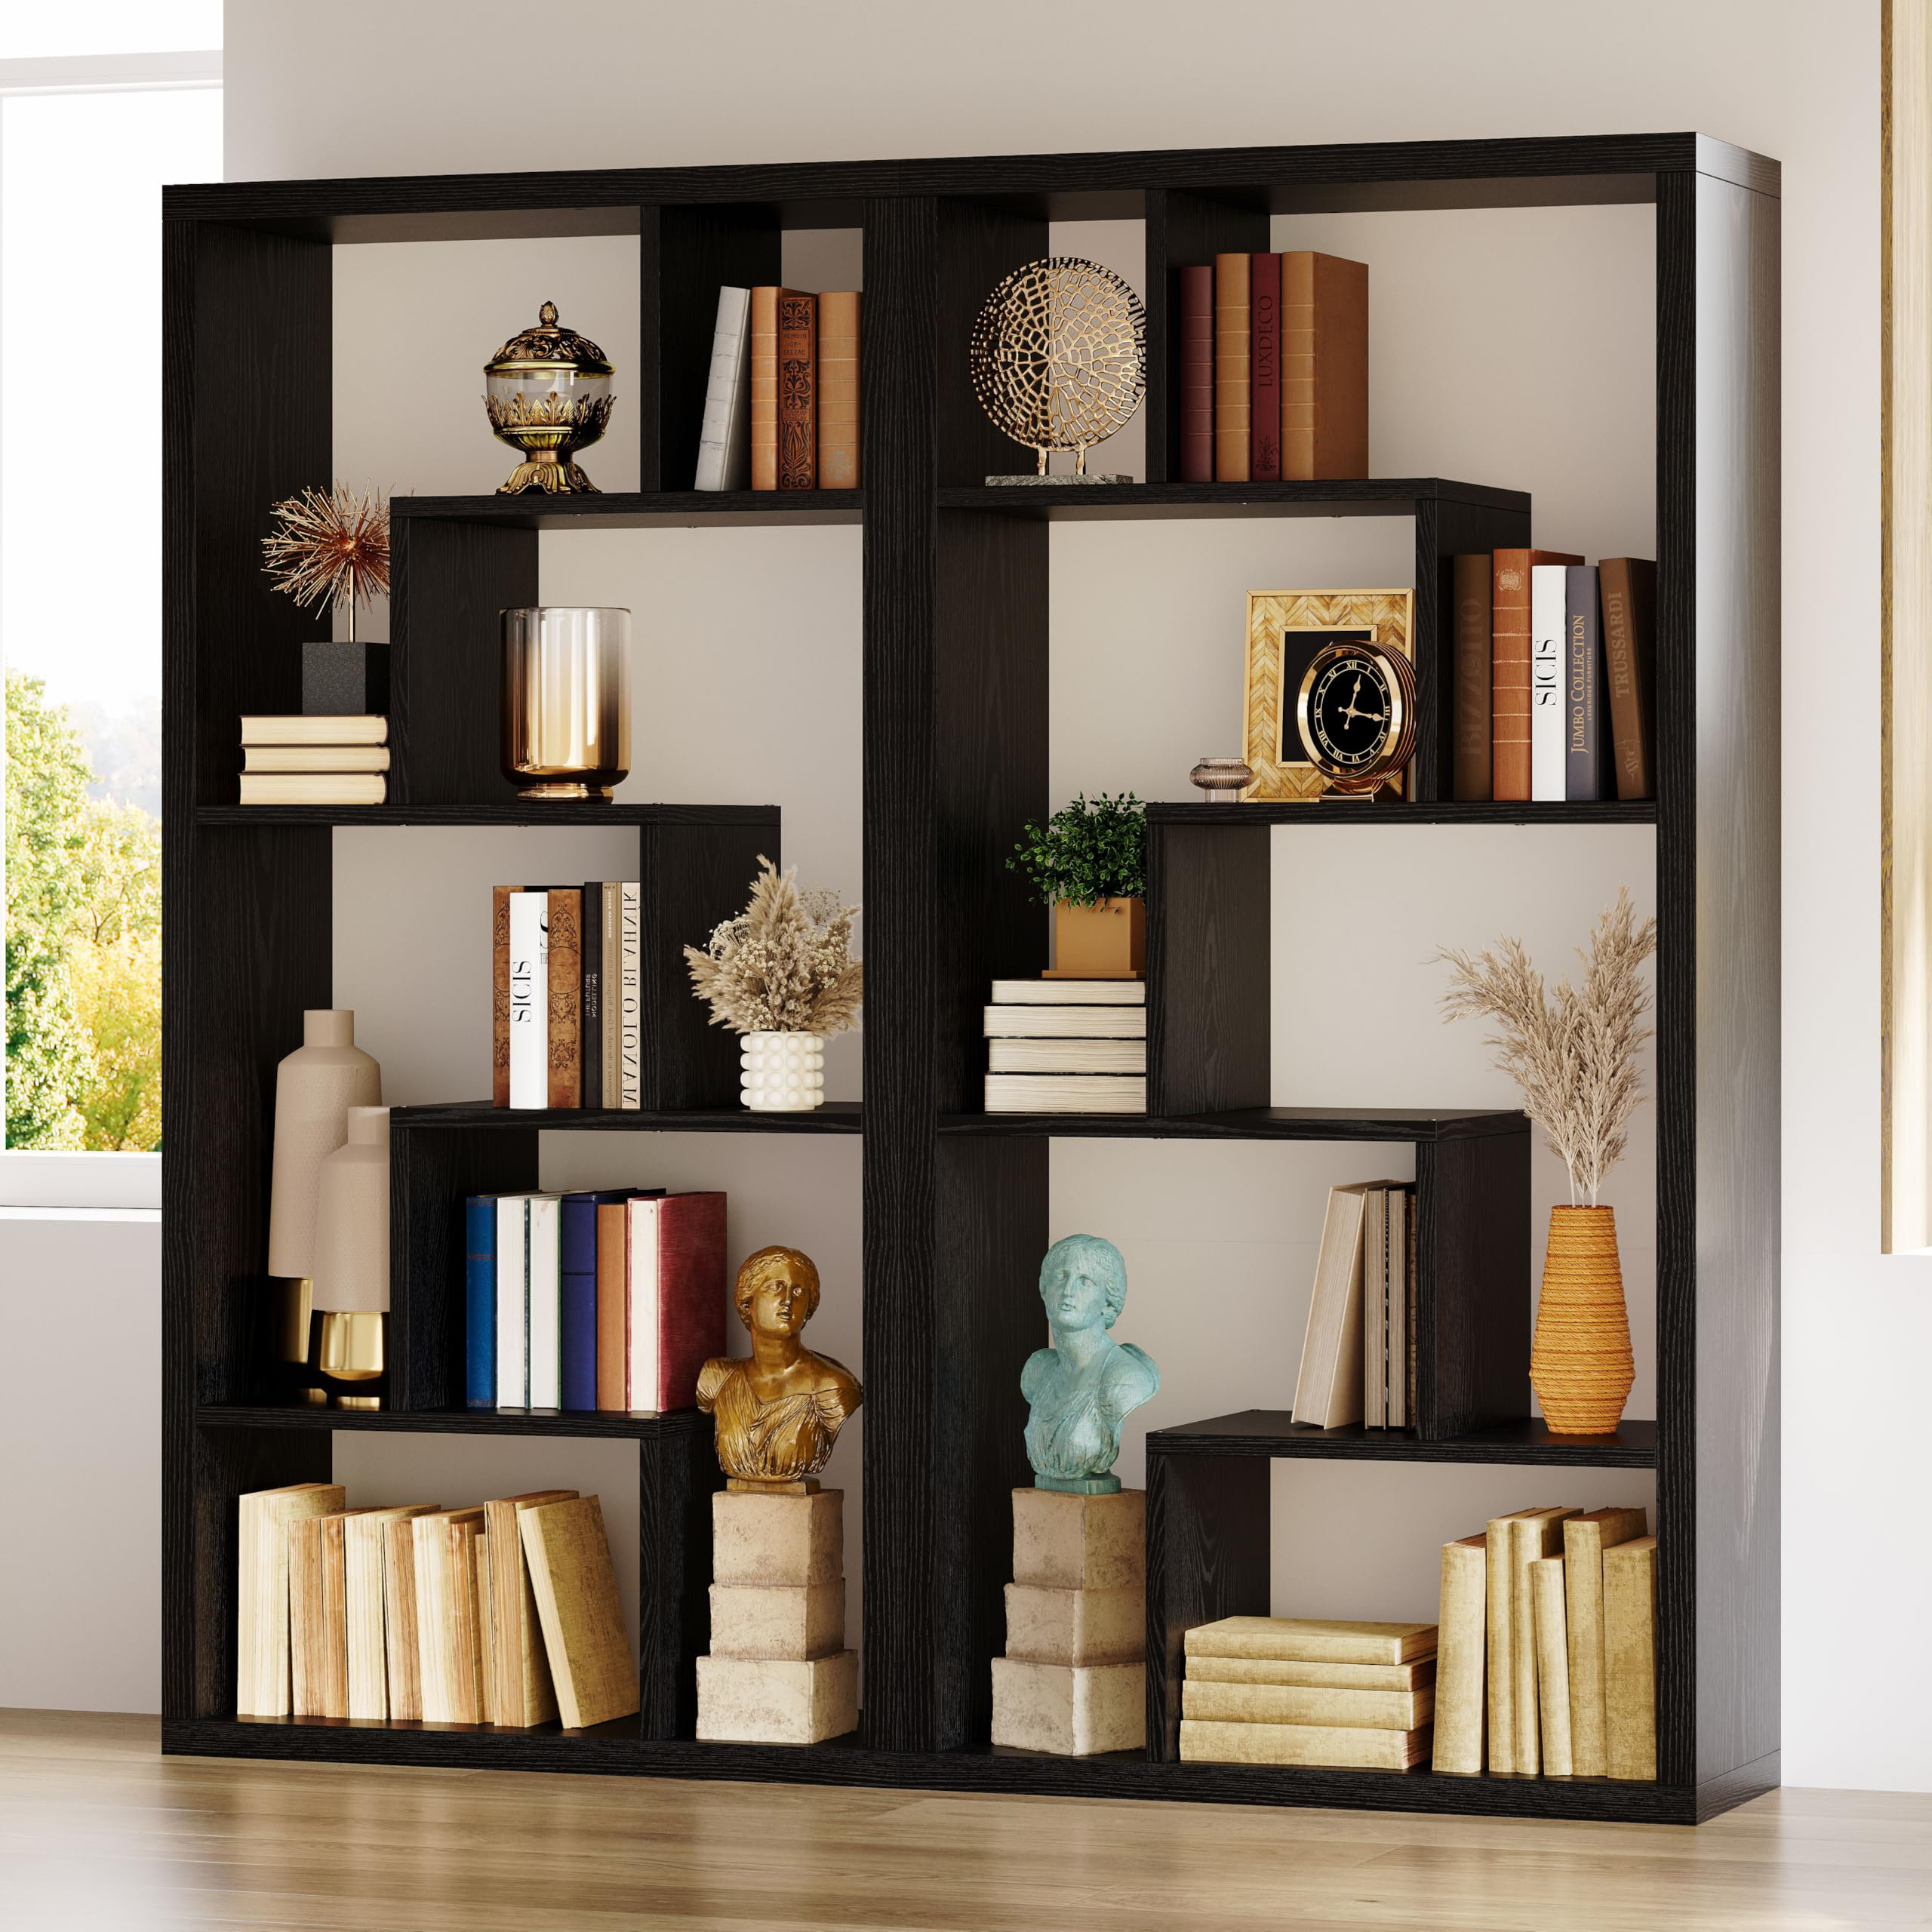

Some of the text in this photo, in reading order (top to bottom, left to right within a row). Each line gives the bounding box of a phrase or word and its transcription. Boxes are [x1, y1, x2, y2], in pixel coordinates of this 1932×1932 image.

[1258, 295, 1273, 388] LUXDECO
[1534, 638, 1558, 706] SICIS
[1570, 614, 1589, 754] JUMBO COLLECTION
[1607, 591, 1630, 699] TRUSSARDI
[512, 960, 532, 1023] SICIS
